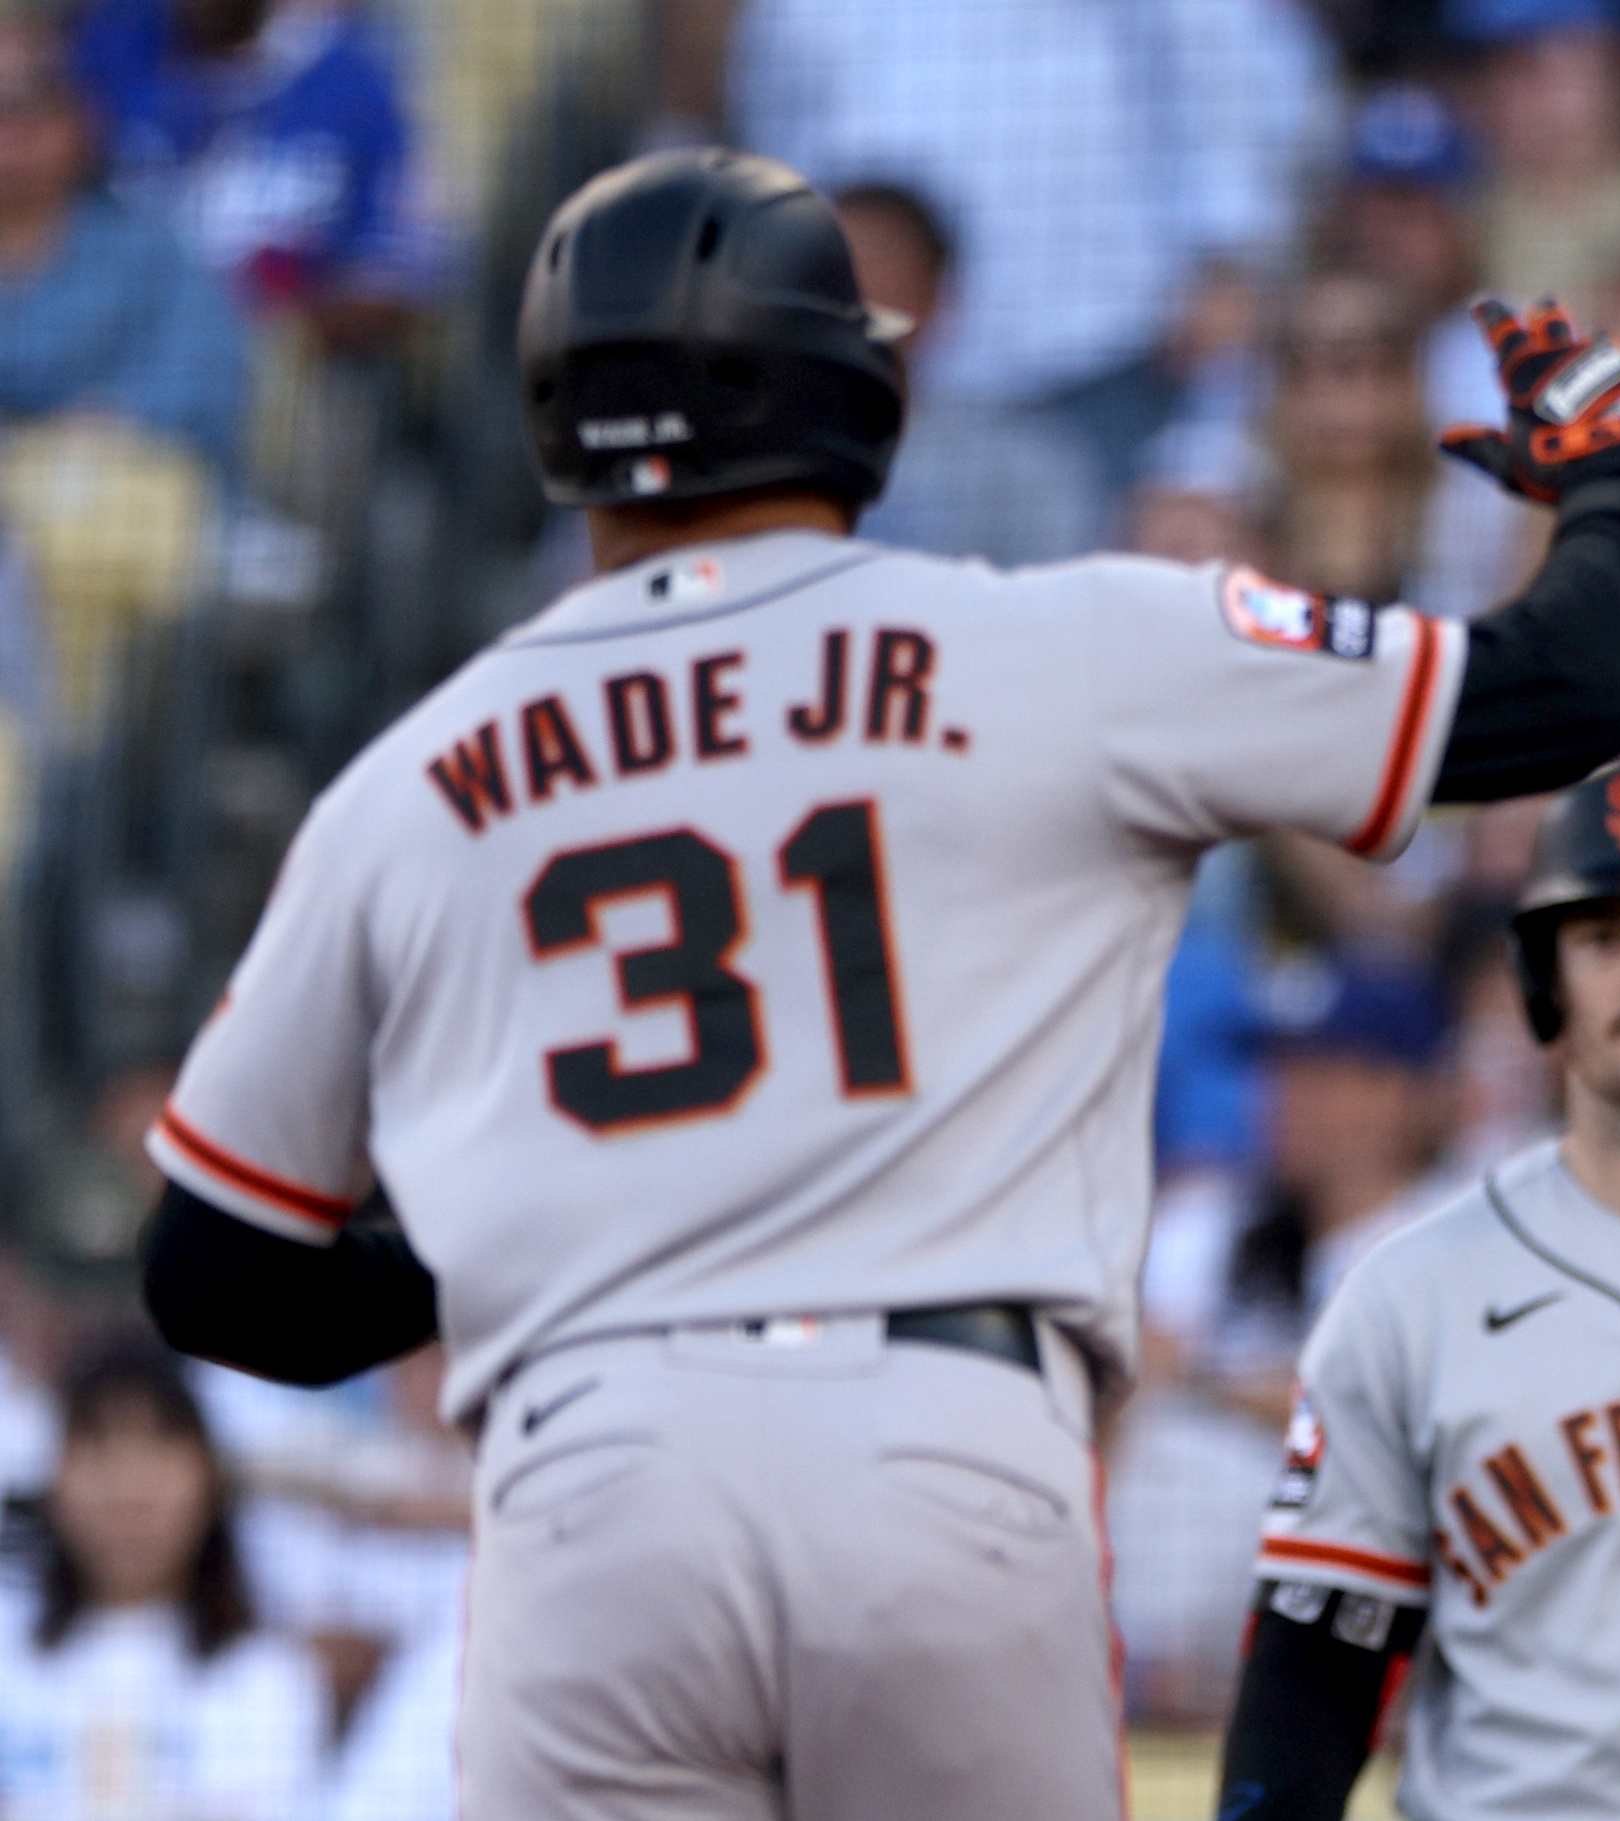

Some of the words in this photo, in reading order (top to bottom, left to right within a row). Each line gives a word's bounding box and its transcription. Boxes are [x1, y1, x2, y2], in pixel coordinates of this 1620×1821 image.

[425, 648, 752, 838] WADE
[786, 625, 971, 756] JR.
[519, 796, 917, 1141] 31
